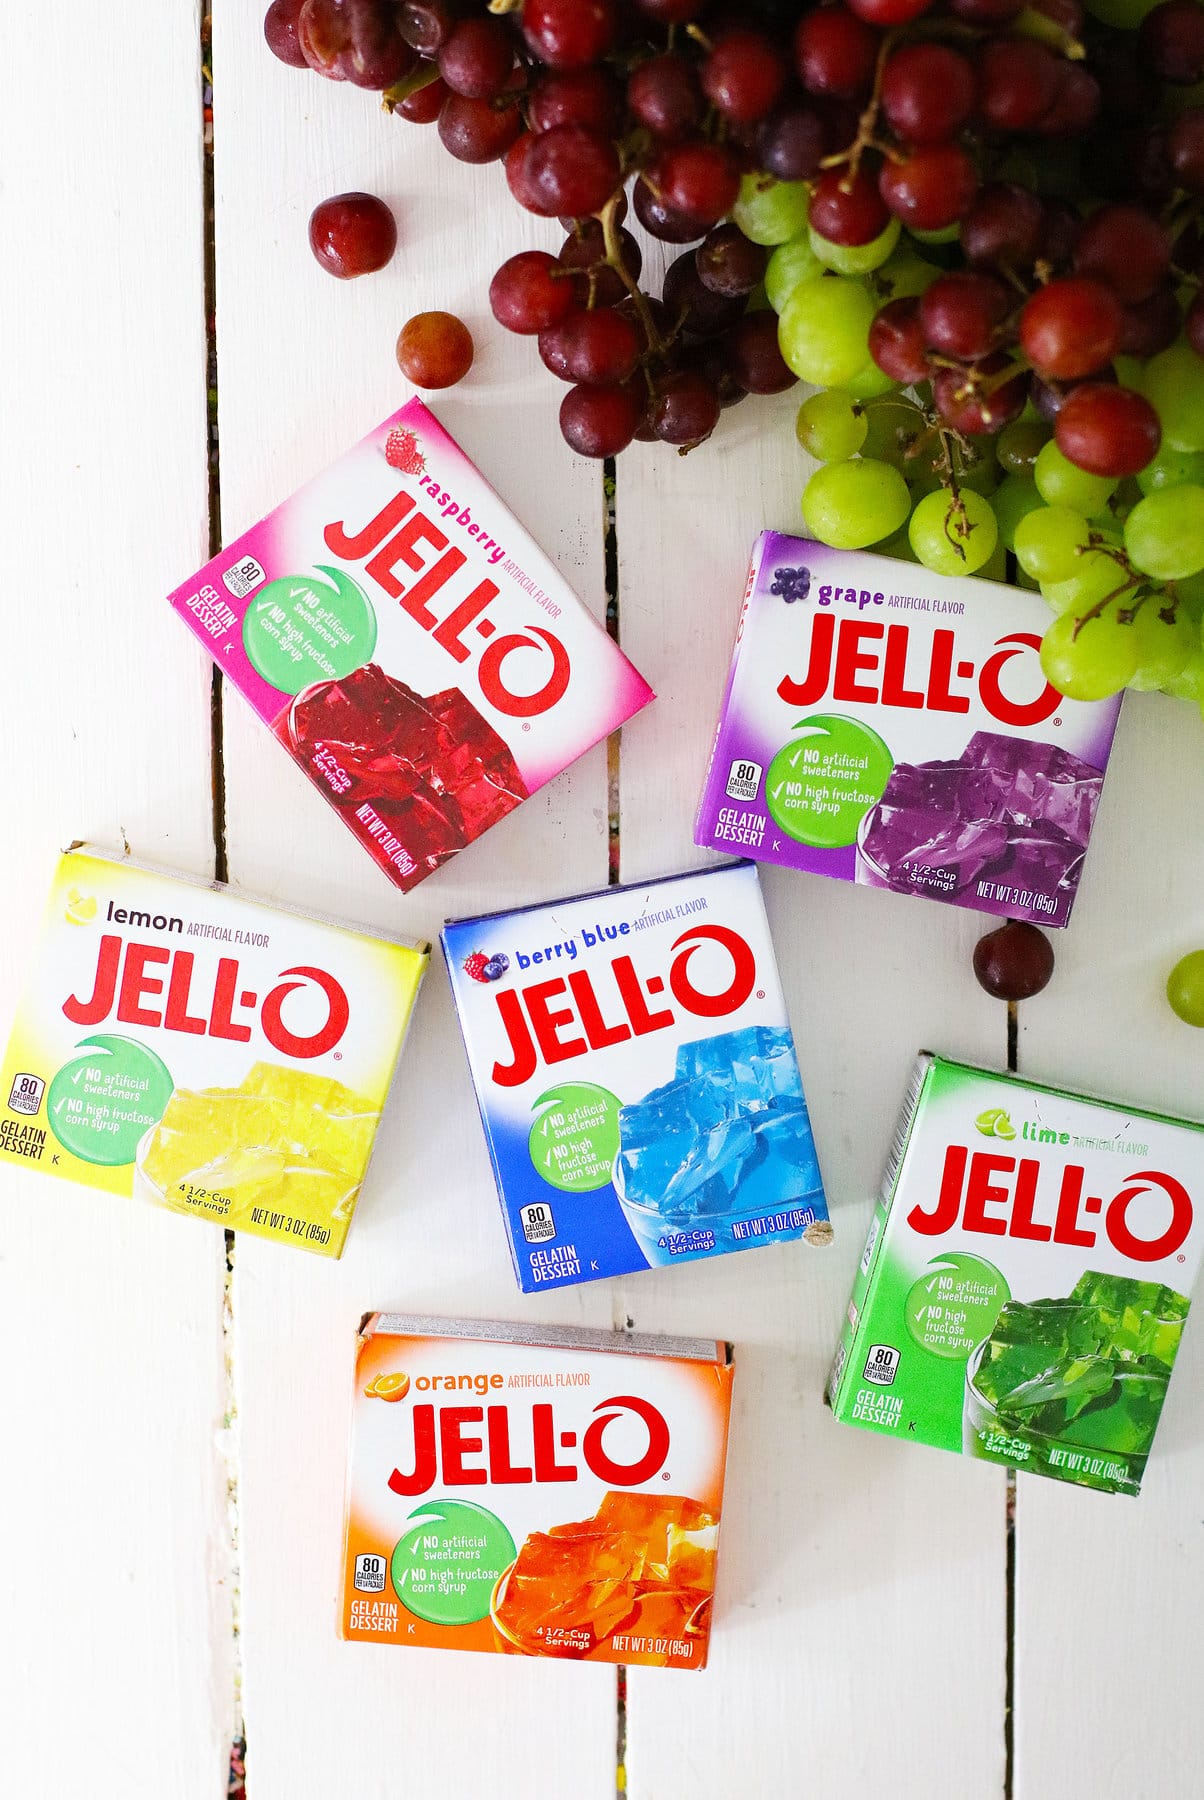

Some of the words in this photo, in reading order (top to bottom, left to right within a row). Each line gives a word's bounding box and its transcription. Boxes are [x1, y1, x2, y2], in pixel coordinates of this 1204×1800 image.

[419, 475, 506, 564] raspberry
[500, 558, 539, 596] ARTIFICIAL
[532, 590, 563, 620] FLAVOR
[240, 561, 262, 583] 80
[198, 583, 239, 629] GELATIN
[819, 586, 885, 610] grape
[888, 595, 931, 611] ARTIFICIAL
[933, 600, 965, 615] FLAVOR
[185, 593, 228, 640] DESSERT
[293, 602, 339, 648] sweeteners
[301, 590, 322, 609] NO
[315, 607, 355, 645] artificial
[223, 643, 235, 654] K
[259, 617, 282, 639] corn
[278, 636, 304, 663] syrup
[267, 606, 287, 624] NO
[281, 620, 307, 644] high
[301, 639, 337, 677] fructose
[313, 741, 324, 751] 4
[320, 749, 354, 790] 1/2-Cup
[803, 749, 821, 763] NO
[823, 755, 868, 769] artificial
[312, 754, 346, 796] Servings
[737, 764, 757, 781] 80
[802, 765, 859, 781] sweeteners
[730, 777, 758, 791] CALORIES
[786, 782, 803, 796] NO
[805, 785, 830, 802] high
[832, 788, 875, 805] fructose
[355, 803, 377, 824] NET
[784, 798, 808, 810] corn
[810, 802, 841, 815] syrup
[367, 817, 388, 838] WT
[717, 807, 767, 832] GELATIN
[377, 831, 392, 844] 3
[383, 837, 401, 854] OZ
[713, 823, 766, 847] DESSERT
[772, 841, 781, 851] K
[389, 848, 418, 876] (85g)
[903, 861, 911, 870] 4
[912, 864, 958, 884] 1/2-Cup
[910, 873, 955, 893] Servings
[977, 881, 995, 898] NET
[995, 885, 1012, 902] WT
[1011, 889, 1019, 904] 3
[1019, 891, 1033, 907] OZ
[1032, 893, 1058, 915] (85g)
[107, 901, 184, 933] lemon
[187, 922, 233, 942] ARTIFICIAL
[235, 930, 269, 948] FLAVOR
[515, 940, 578, 970] berry
[581, 922, 632, 948] blue
[633, 908, 676, 932] ARTIFICIAL
[675, 898, 708, 918] FLAVOR
[20, 1078, 38, 1096] 80
[85, 1067, 103, 1082] NO
[104, 1075, 149, 1091] artificial
[83, 1083, 140, 1102] sweeteners
[67, 1099, 84, 1113] NO
[86, 1103, 111, 1120] high
[113, 1107, 155, 1126] fructose
[549, 1113, 565, 1128] NO
[566, 1099, 609, 1122] artificial
[1, 1120, 47, 1145] GELATIN
[65, 1114, 89, 1126] corn
[91, 1119, 121, 1134] syrup
[554, 1115, 606, 1139] sweeteners
[552, 1144, 569, 1159] NO
[569, 1137, 593, 1154] high
[1024, 1122, 1070, 1145] lime
[1117, 1141, 1149, 1156] FLAVOR
[52, 1154, 60, 1165] K
[558, 1152, 597, 1172] fructose
[562, 1169, 584, 1183] corn
[585, 1160, 613, 1176] syrup
[180, 1182, 188, 1191] 4
[188, 1185, 232, 1206] 1/2-Cup
[185, 1193, 230, 1215] Servings
[252, 1206, 270, 1223] NET
[270, 1210, 287, 1227] WT
[285, 1216, 294, 1230] 3
[293, 1217, 307, 1233] OZ
[304, 1221, 330, 1242] (85g)
[527, 1206, 546, 1224] 80
[732, 1221, 750, 1240] NET
[751, 1217, 768, 1235] WT
[767, 1217, 775, 1232] 3
[775, 1213, 790, 1230] OZ
[789, 1208, 816, 1229] (85g)
[525, 1220, 553, 1233] CALORIES
[658, 1238, 666, 1247] 4
[668, 1229, 714, 1245] 1/2-Cup
[670, 1239, 716, 1254] Servings
[529, 1245, 577, 1268] GELATIN
[590, 1260, 600, 1270] K
[532, 1260, 582, 1283] DESSERT
[939, 1276, 953, 1290] NO
[956, 1281, 998, 1297] artificial
[937, 1290, 990, 1306] sweeteners
[927, 1305, 943, 1319] NO
[945, 1308, 967, 1325] high
[926, 1319, 965, 1335] fructose
[923, 1334, 946, 1345] corn
[947, 1337, 975, 1351] syrup
[874, 1349, 893, 1367] 80
[867, 1362, 895, 1376] CALORIES
[416, 1373, 504, 1396] orange
[508, 1375, 554, 1388] ARTIFICIAL
[555, 1373, 591, 1387] FLAVOR
[856, 1388, 904, 1414] GELATIN
[852, 1403, 902, 1428] DESSERT
[908, 1422, 918, 1432] K
[978, 1431, 987, 1441] 4
[989, 1433, 1032, 1455] 1/2-Cup
[986, 1442, 1030, 1462] Servings
[1049, 1449, 1067, 1466] NET
[1067, 1453, 1085, 1471] WT
[1082, 1458, 1091, 1472] 3
[1090, 1459, 1105, 1475] OZ
[423, 1536, 439, 1549] NO
[443, 1536, 487, 1548] artificial
[363, 1558, 380, 1573] 80
[424, 1550, 480, 1560] sweeteners
[357, 1572, 384, 1581] CALORIES
[412, 1569, 427, 1581] NO
[430, 1569, 454, 1584] high
[457, 1569, 499, 1580] fructose
[412, 1584, 435, 1592] corn
[438, 1584, 467, 1595] syrup
[351, 1601, 398, 1618] GELATIN
[350, 1616, 399, 1632] DESSERT
[408, 1625, 415, 1633] K
[537, 1627, 544, 1635] 4
[546, 1628, 591, 1641] 1/2-Cup
[545, 1637, 590, 1650] Servings
[613, 1636, 629, 1650] NET
[631, 1637, 646, 1652] WT
[647, 1639, 654, 1653] 3
[655, 1639, 668, 1653] OZ
[669, 1641, 693, 1658] (85g)
